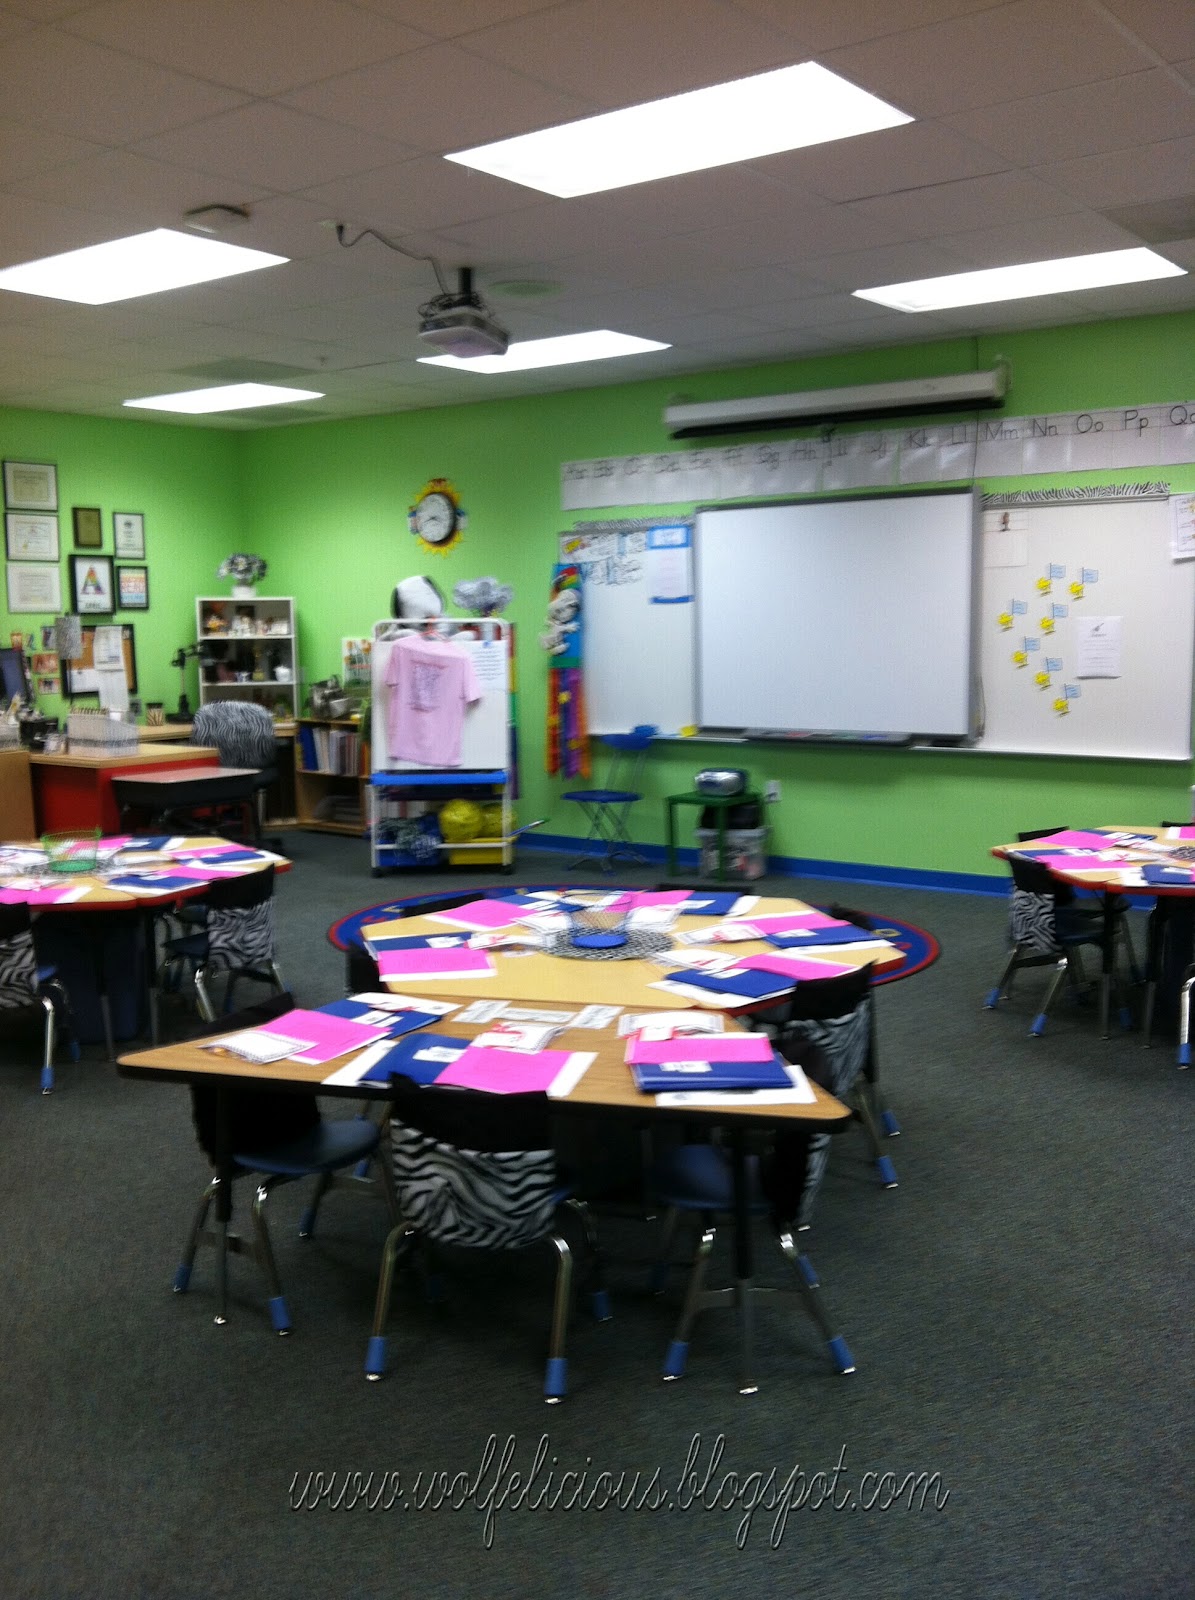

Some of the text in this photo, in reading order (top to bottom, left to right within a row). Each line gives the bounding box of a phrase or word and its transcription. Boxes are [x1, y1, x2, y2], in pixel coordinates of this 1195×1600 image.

[985, 421, 1019, 440] Mm
[1032, 418, 1058, 437] Nn
[1076, 413, 1104, 434] Oo
[1124, 409, 1149, 437] Pp
